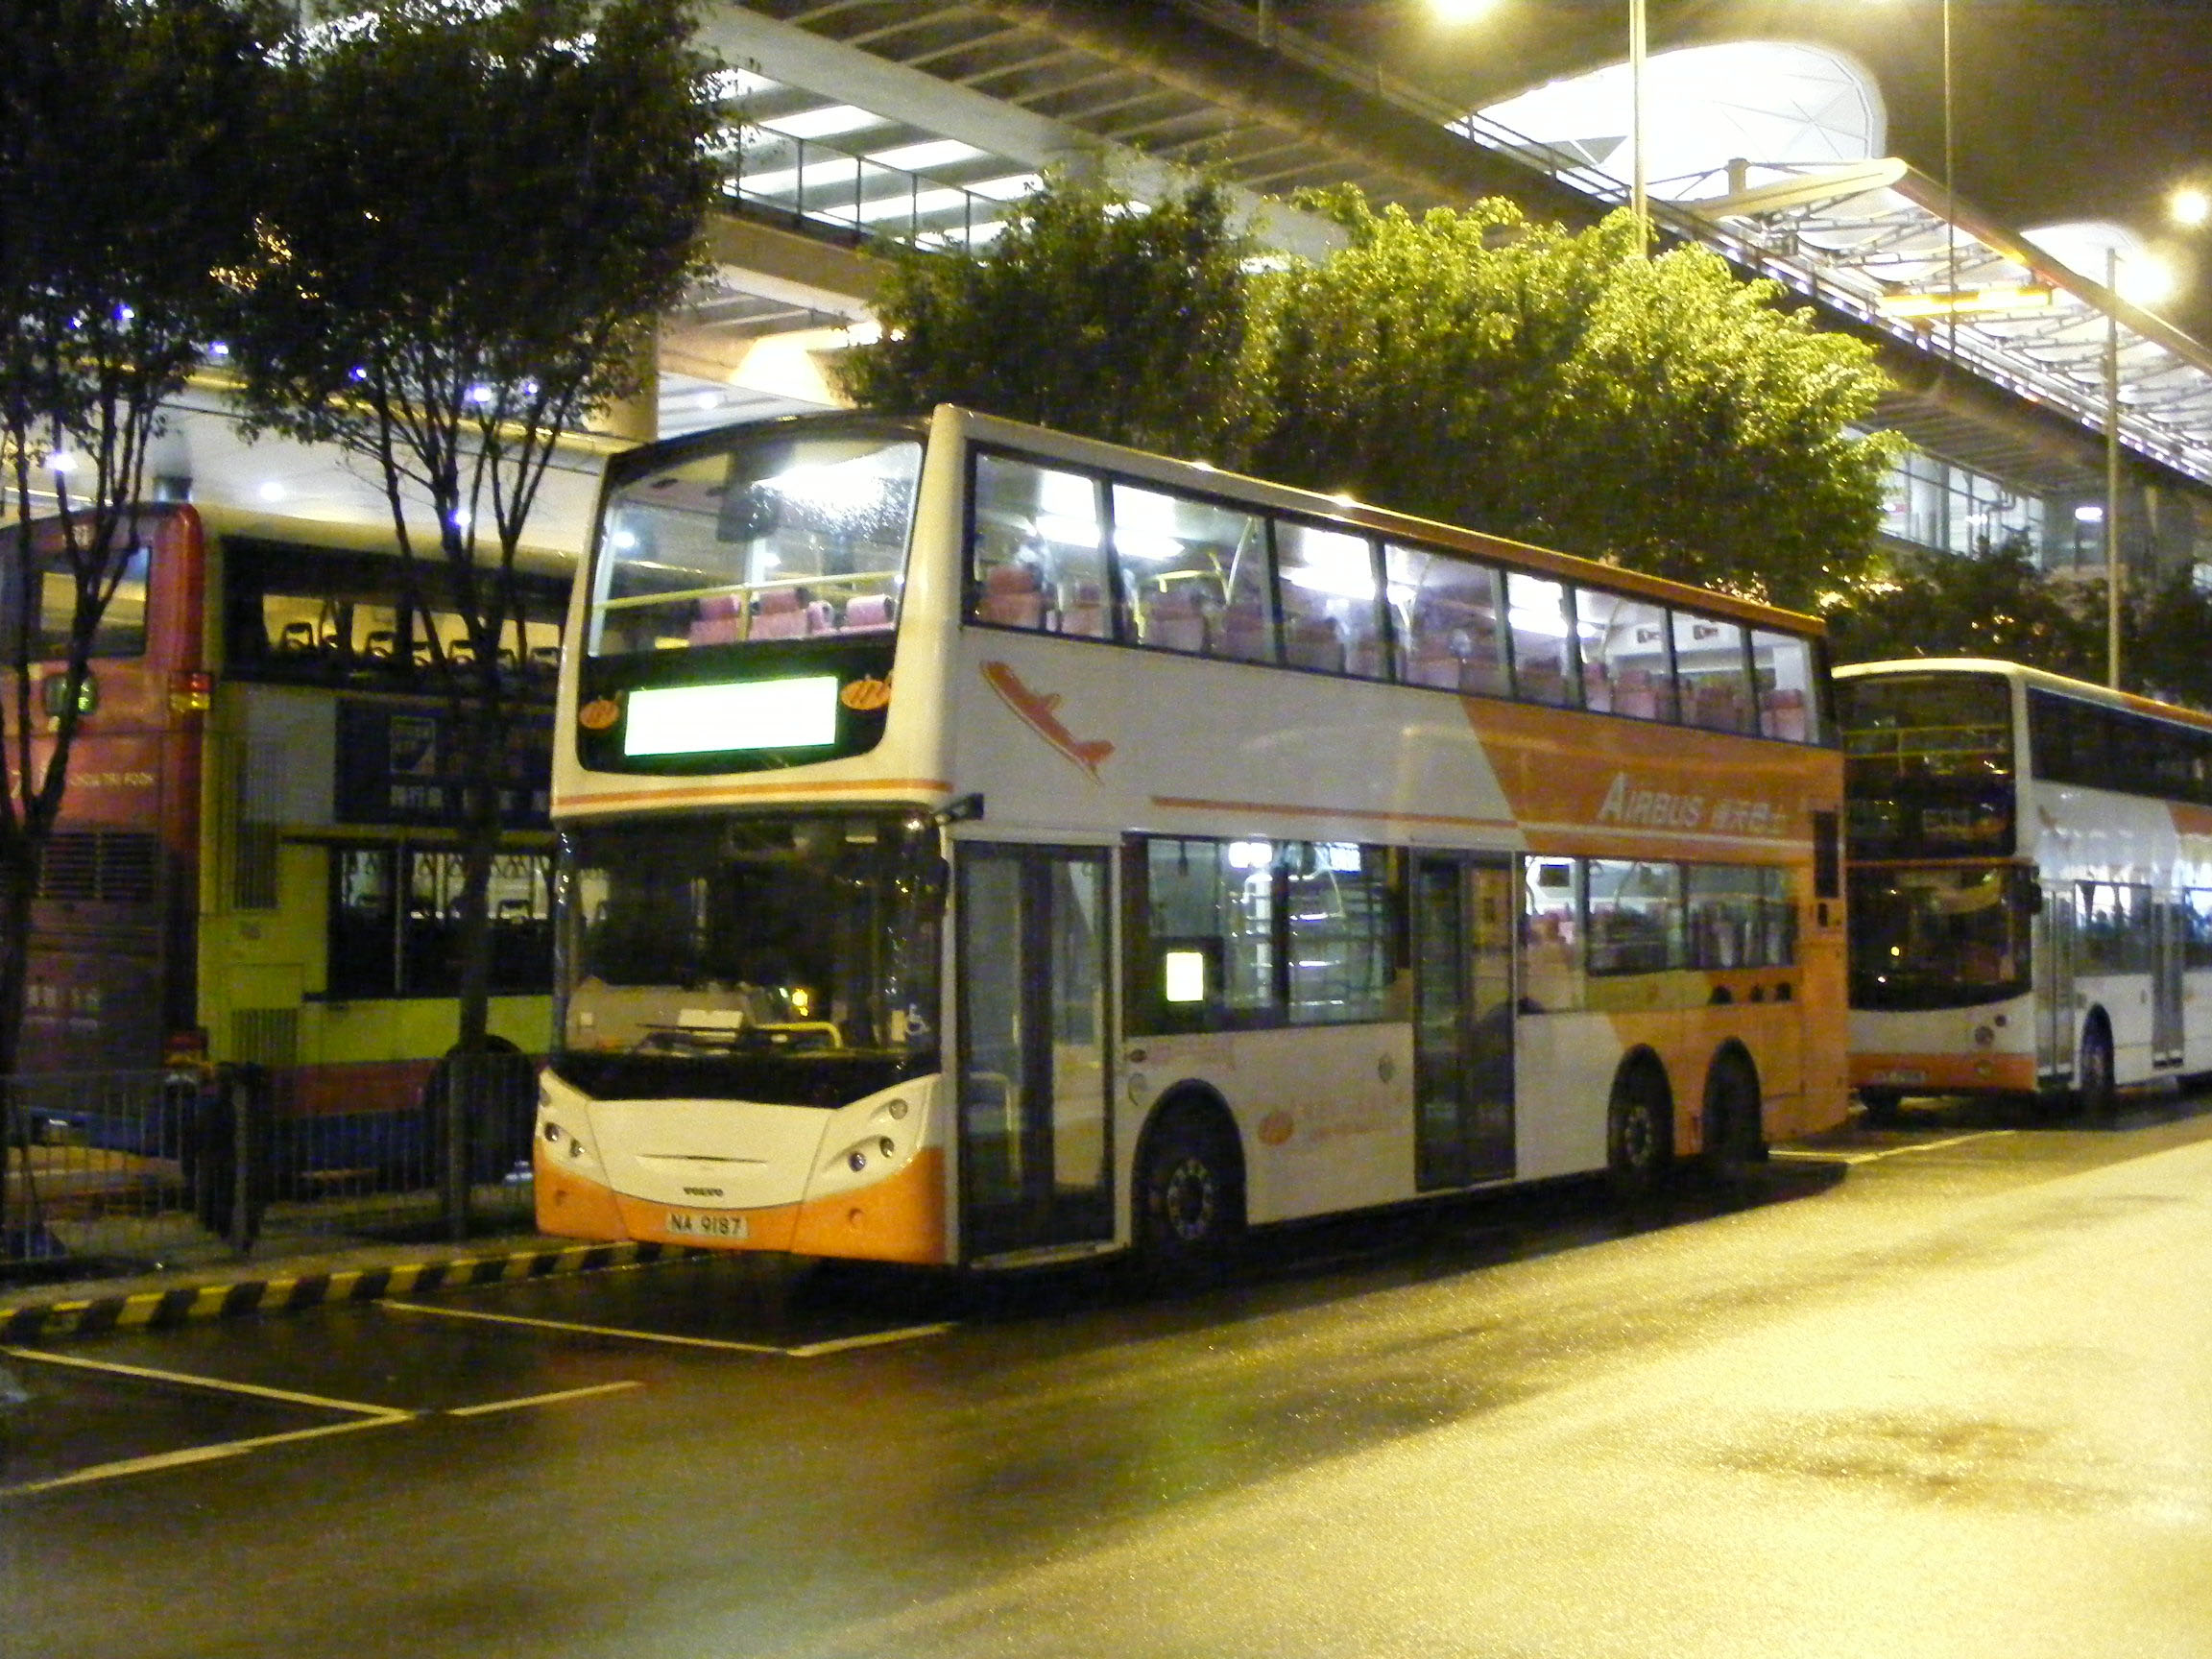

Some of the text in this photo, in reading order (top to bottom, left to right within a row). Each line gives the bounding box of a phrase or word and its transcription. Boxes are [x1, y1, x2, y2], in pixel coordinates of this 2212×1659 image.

[683, 1187, 724, 1197] VOLVO
[671, 1214, 741, 1236] NA 9187
